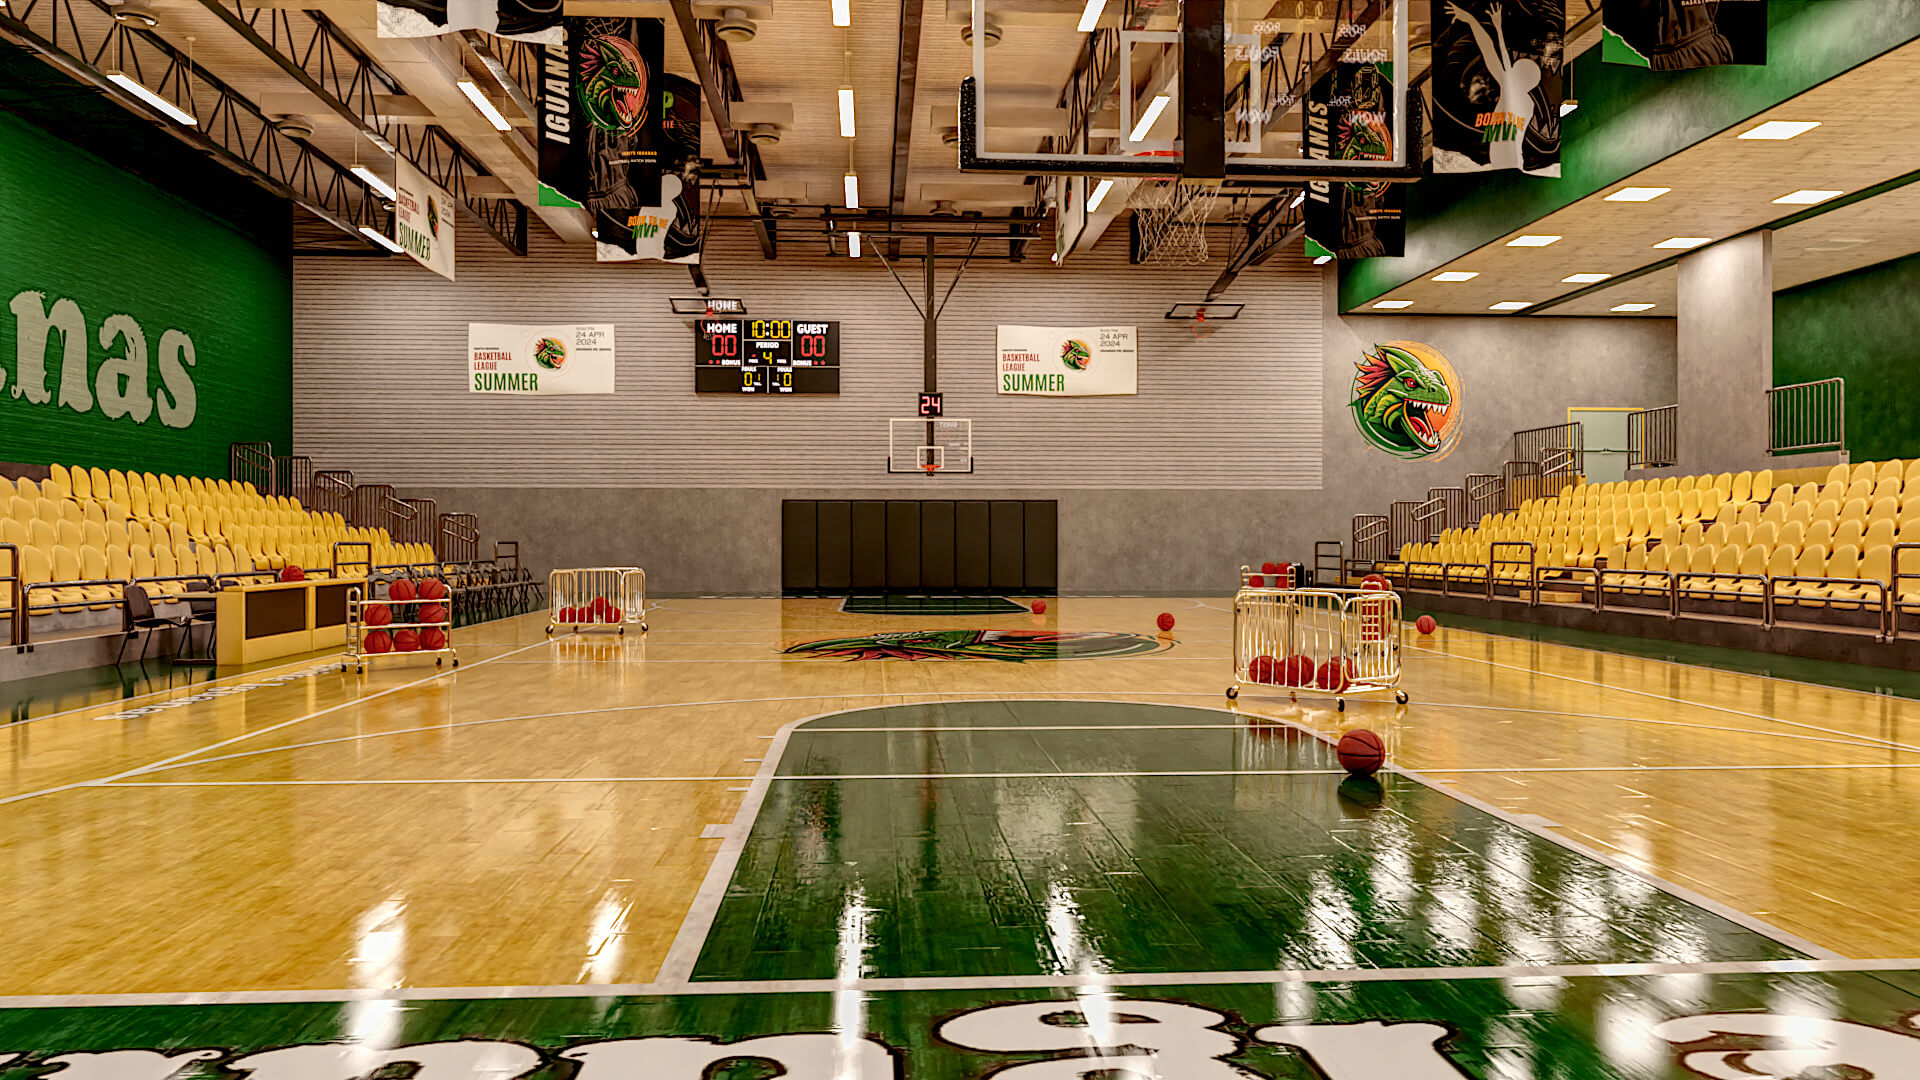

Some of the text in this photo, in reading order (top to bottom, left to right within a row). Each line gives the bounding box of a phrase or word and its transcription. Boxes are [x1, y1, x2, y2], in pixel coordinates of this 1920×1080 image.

[1475, 112, 1506, 127] BORN
[1309, 101, 1330, 204] IGANAS
[632, 223, 659, 239] MVP
[400, 222, 431, 262] SUMMER
[589, 331, 605, 339] APR
[706, 320, 829, 339] HOME 10:00 GUEST
[576, 338, 597, 346] 2024
[711, 335, 826, 357] 00 00
[755, 341, 780, 349] PERIOD
[0, 290, 197, 428] nas
[474, 352, 512, 361] BASKETBALL
[762, 351, 773, 365] 4
[1002, 353, 1041, 362] BASKETBALL
[474, 361, 498, 370] LEAGUE
[1002, 363, 1025, 371] LEAGUE
[474, 373, 539, 391] SUMMER
[743, 372, 753, 387] 0
[783, 372, 792, 387] 0
[1003, 374, 1065, 391] SUMMER
[920, 395, 941, 415] 24
